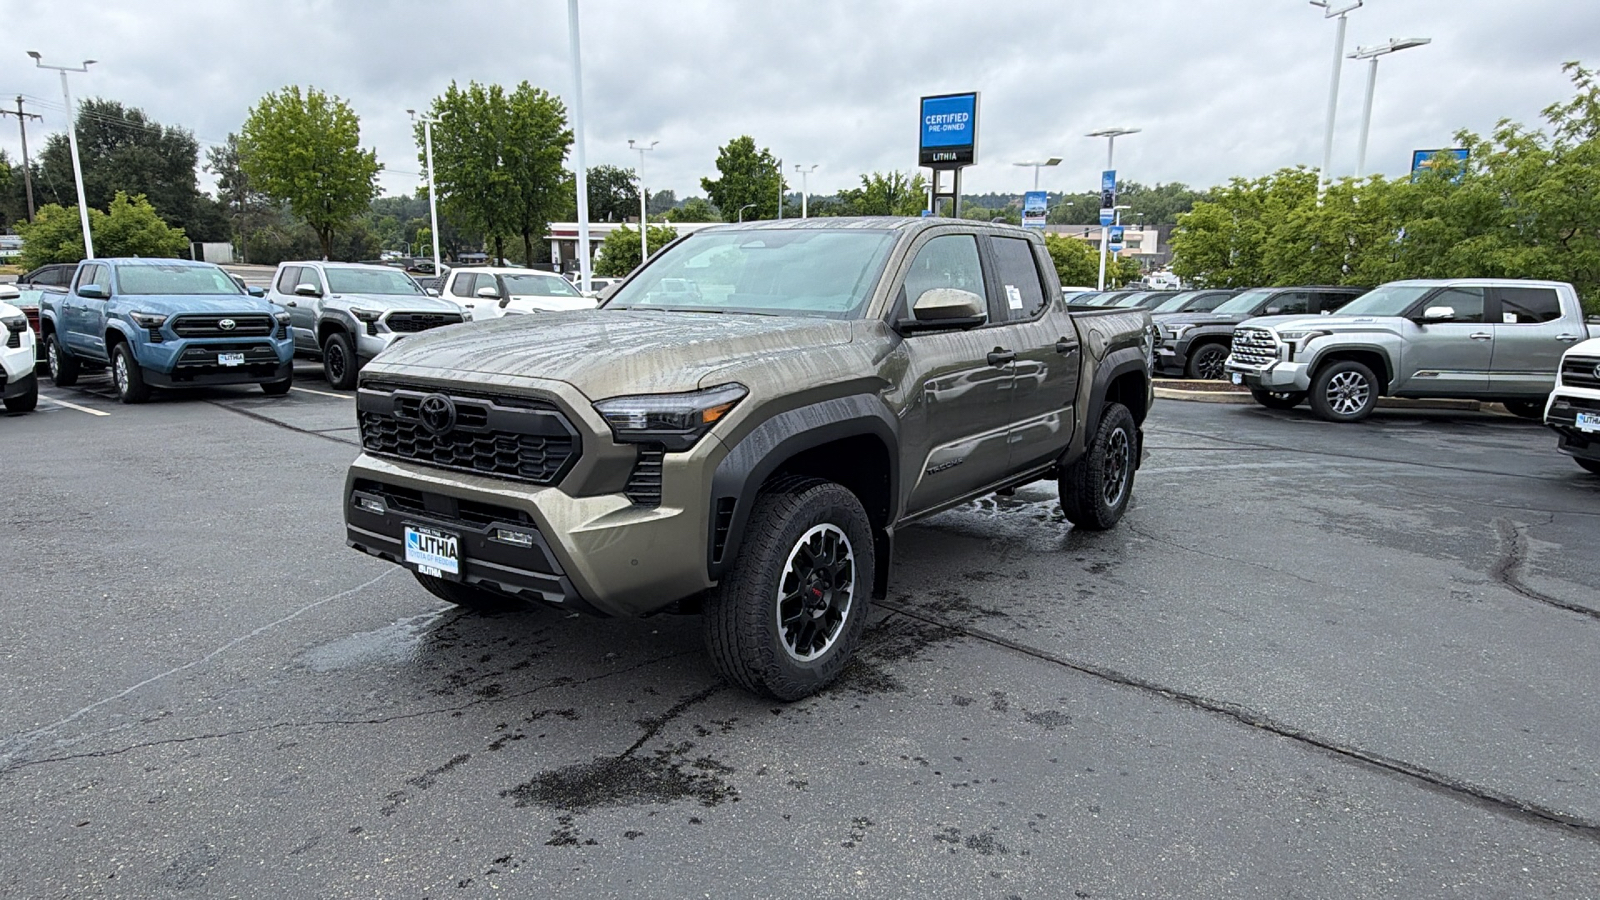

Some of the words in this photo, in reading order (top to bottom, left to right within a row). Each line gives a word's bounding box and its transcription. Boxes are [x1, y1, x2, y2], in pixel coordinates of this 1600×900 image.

[925, 112, 969, 124] CERTIFIED
[928, 123, 965, 132] PRE-OWNED
[932, 152, 957, 161] LITHIA
[418, 535, 458, 559] LITHIA
[408, 548, 426, 559] TOYOTA
[434, 556, 458, 567] REDDIN
[423, 566, 442, 578] LITHIA
